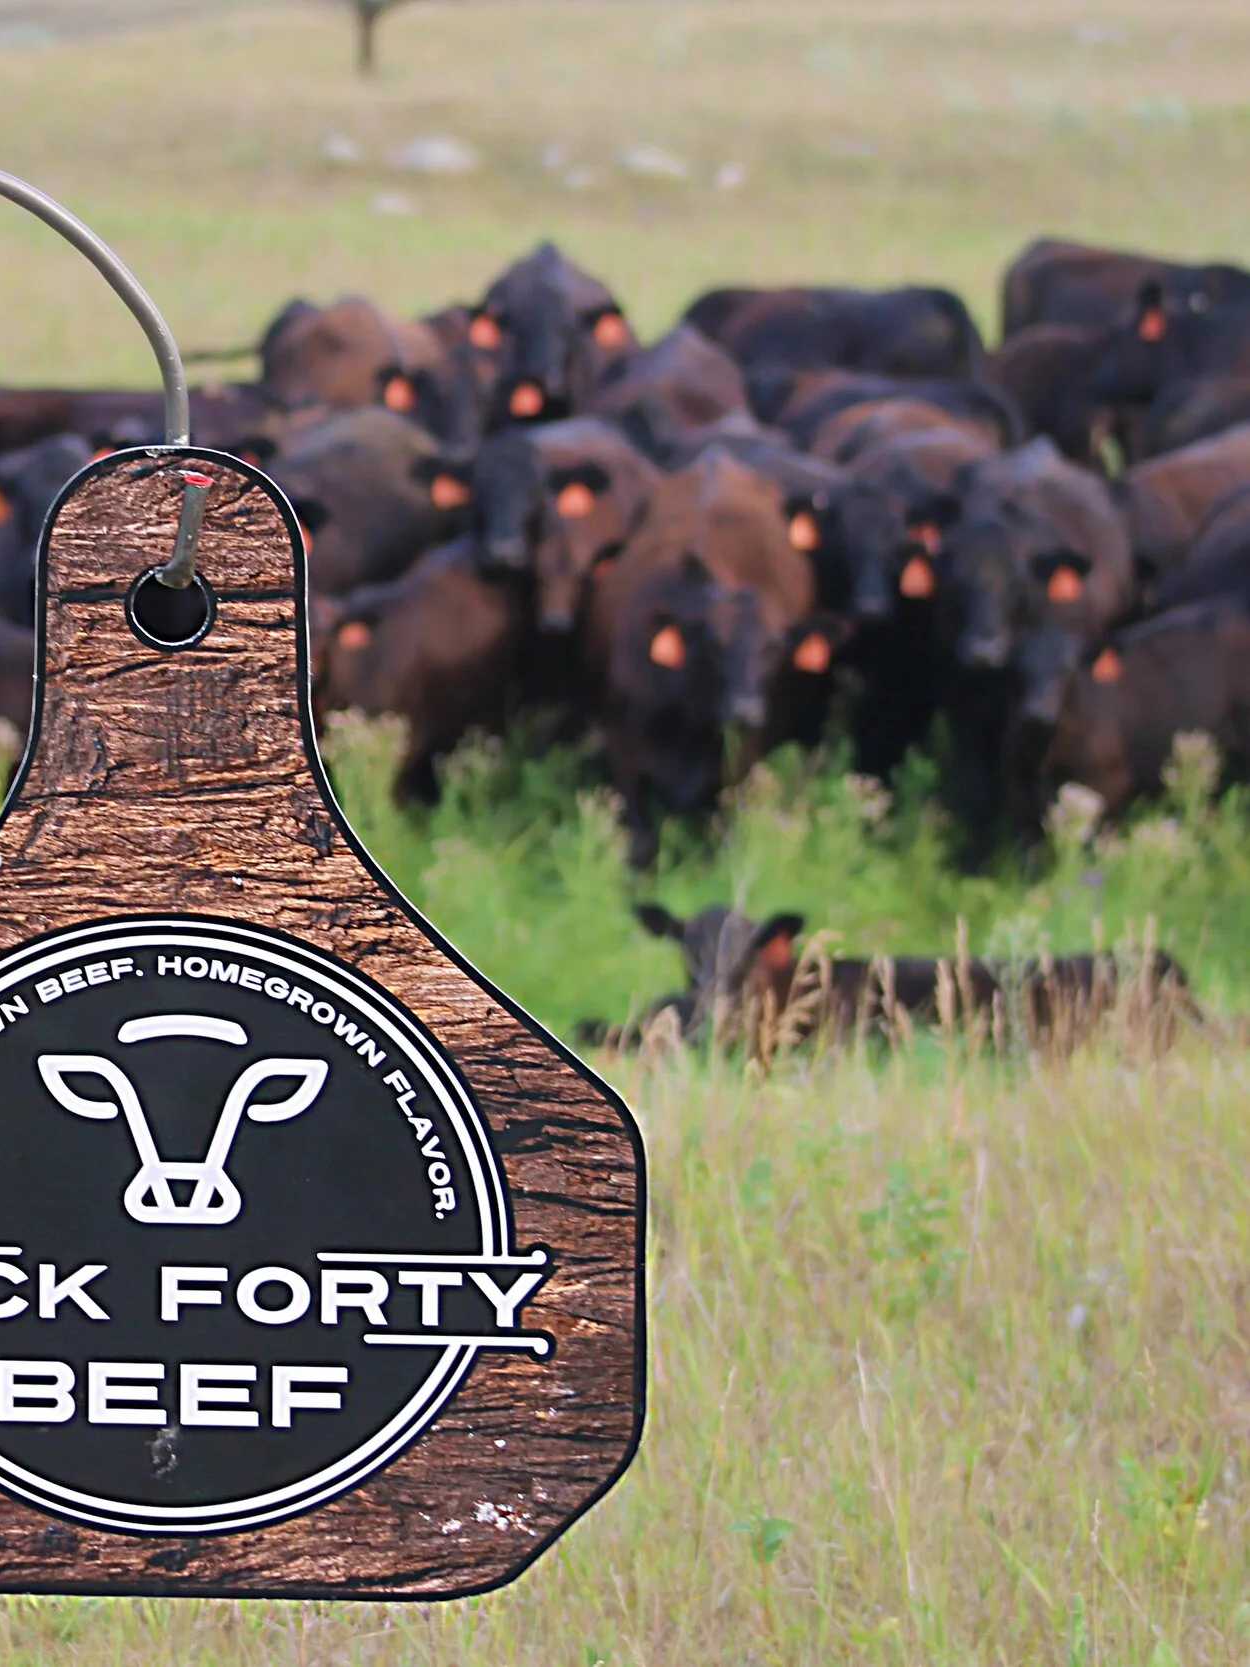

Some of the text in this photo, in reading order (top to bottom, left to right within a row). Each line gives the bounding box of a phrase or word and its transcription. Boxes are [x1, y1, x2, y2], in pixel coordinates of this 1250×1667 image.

[34, 957, 144, 1004] BEEF.
[157, 955, 387, 1068] HOMEGROWN
[382, 1069, 456, 1220] FLAVOR.
[161, 1266, 543, 1328] FORTY
